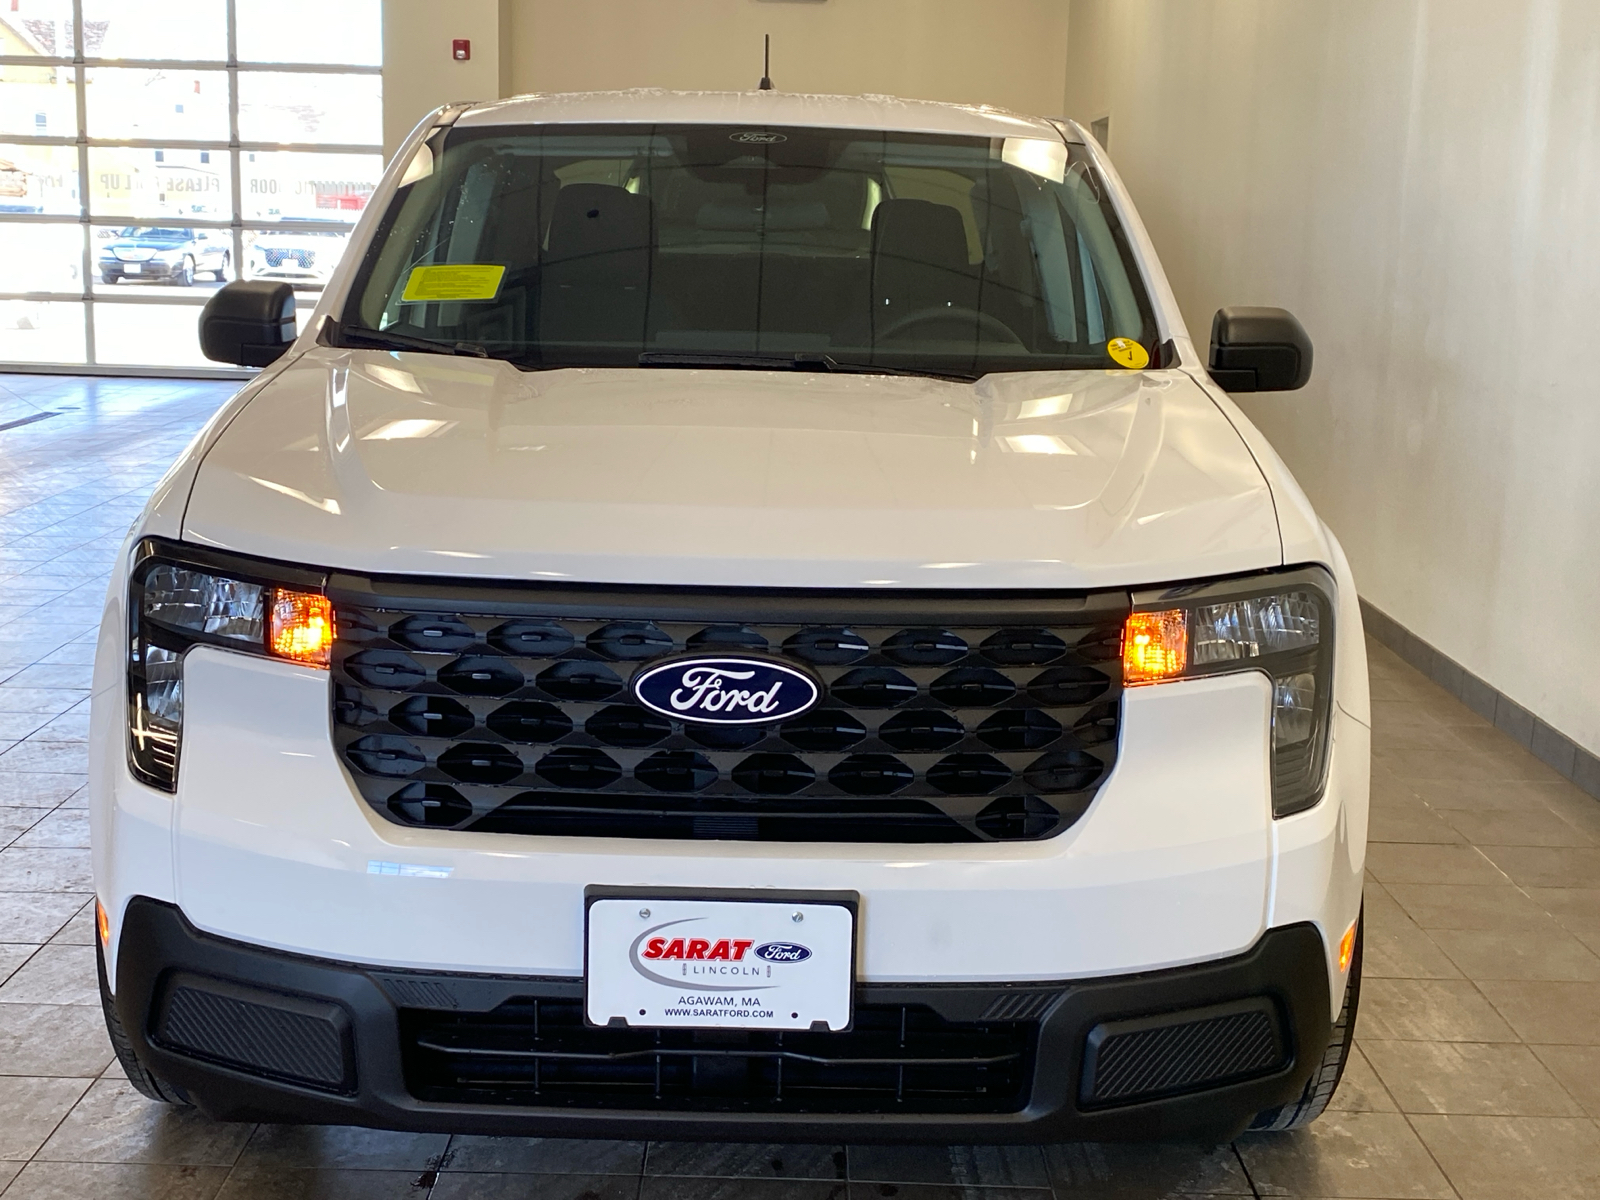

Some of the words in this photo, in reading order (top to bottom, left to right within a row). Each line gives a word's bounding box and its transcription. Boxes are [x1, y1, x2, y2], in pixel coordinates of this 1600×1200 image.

[739, 132, 777, 142] Ford
[670, 666, 783, 713] Ford
[642, 936, 755, 962] SARAT
[764, 944, 802, 961] Ford
[693, 965, 760, 976] LINCOLN
[678, 996, 738, 1007] AGAWAM,
[742, 997, 761, 1007] MA
[664, 1008, 774, 1018] WWW.SARATFORD.COM
